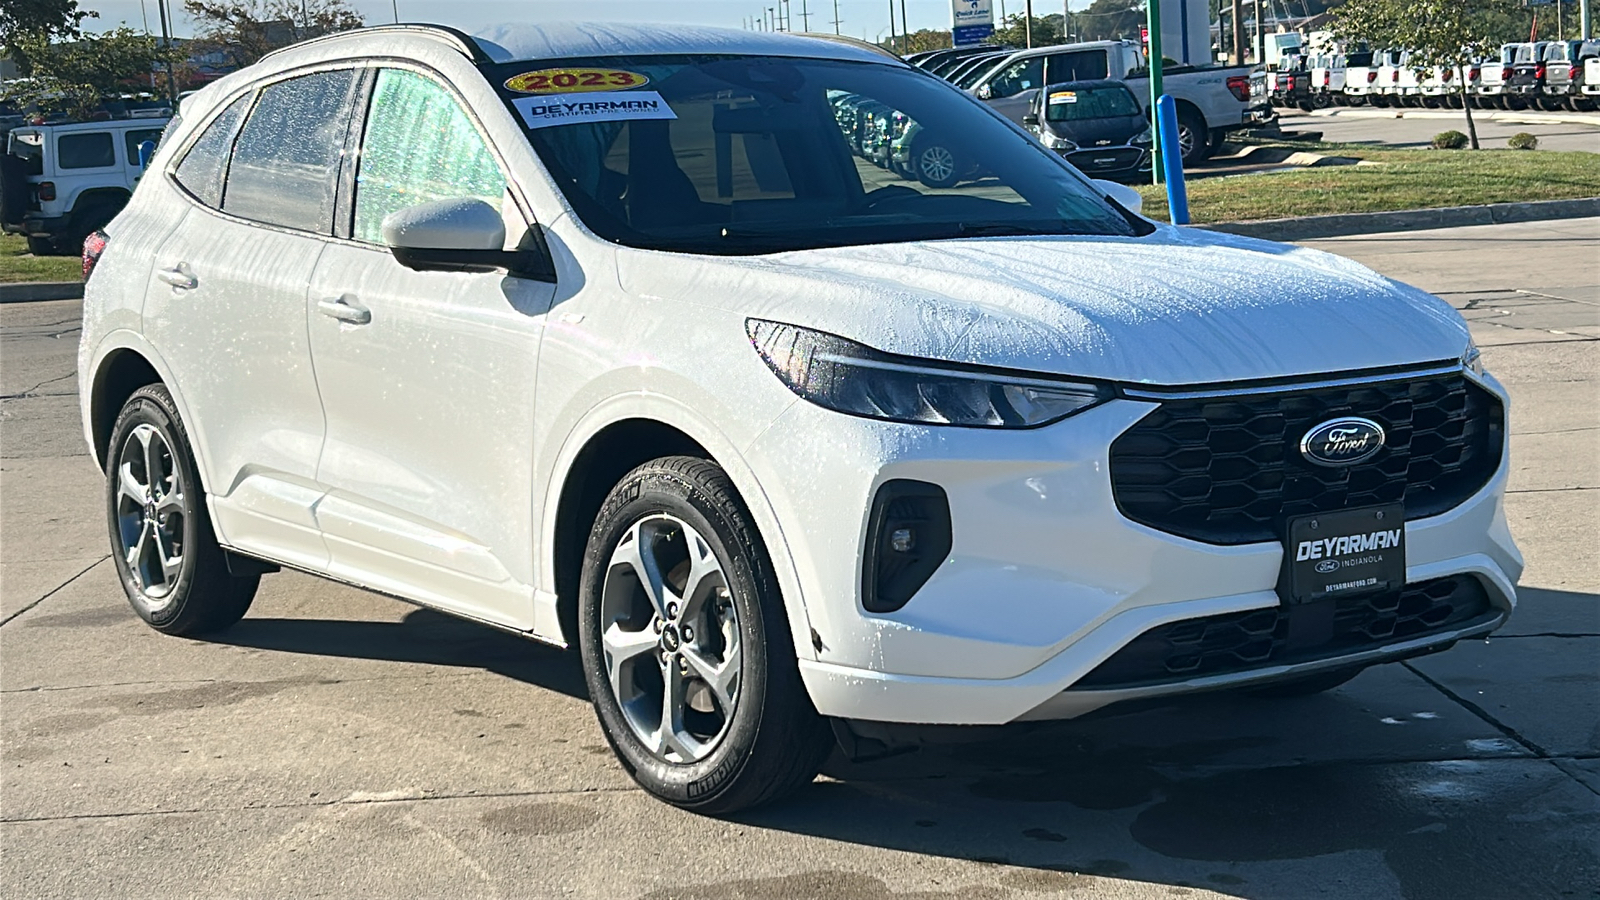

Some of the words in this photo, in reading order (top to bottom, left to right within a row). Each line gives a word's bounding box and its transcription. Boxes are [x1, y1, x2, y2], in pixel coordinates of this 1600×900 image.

[524, 72, 636, 90] 2023
[531, 101, 659, 116] DEYARMAN
[544, 111, 598, 119] CERTIFIED
[601, 107, 660, 115] PRE-OWNED
[1324, 428, 1369, 456] Ford
[1296, 529, 1401, 562] DEYARMAN
[1341, 555, 1383, 568] INDIANOLA
[1325, 577, 1378, 592] DEYARMANFORD.COM
[688, 747, 738, 797] MICHELIN
